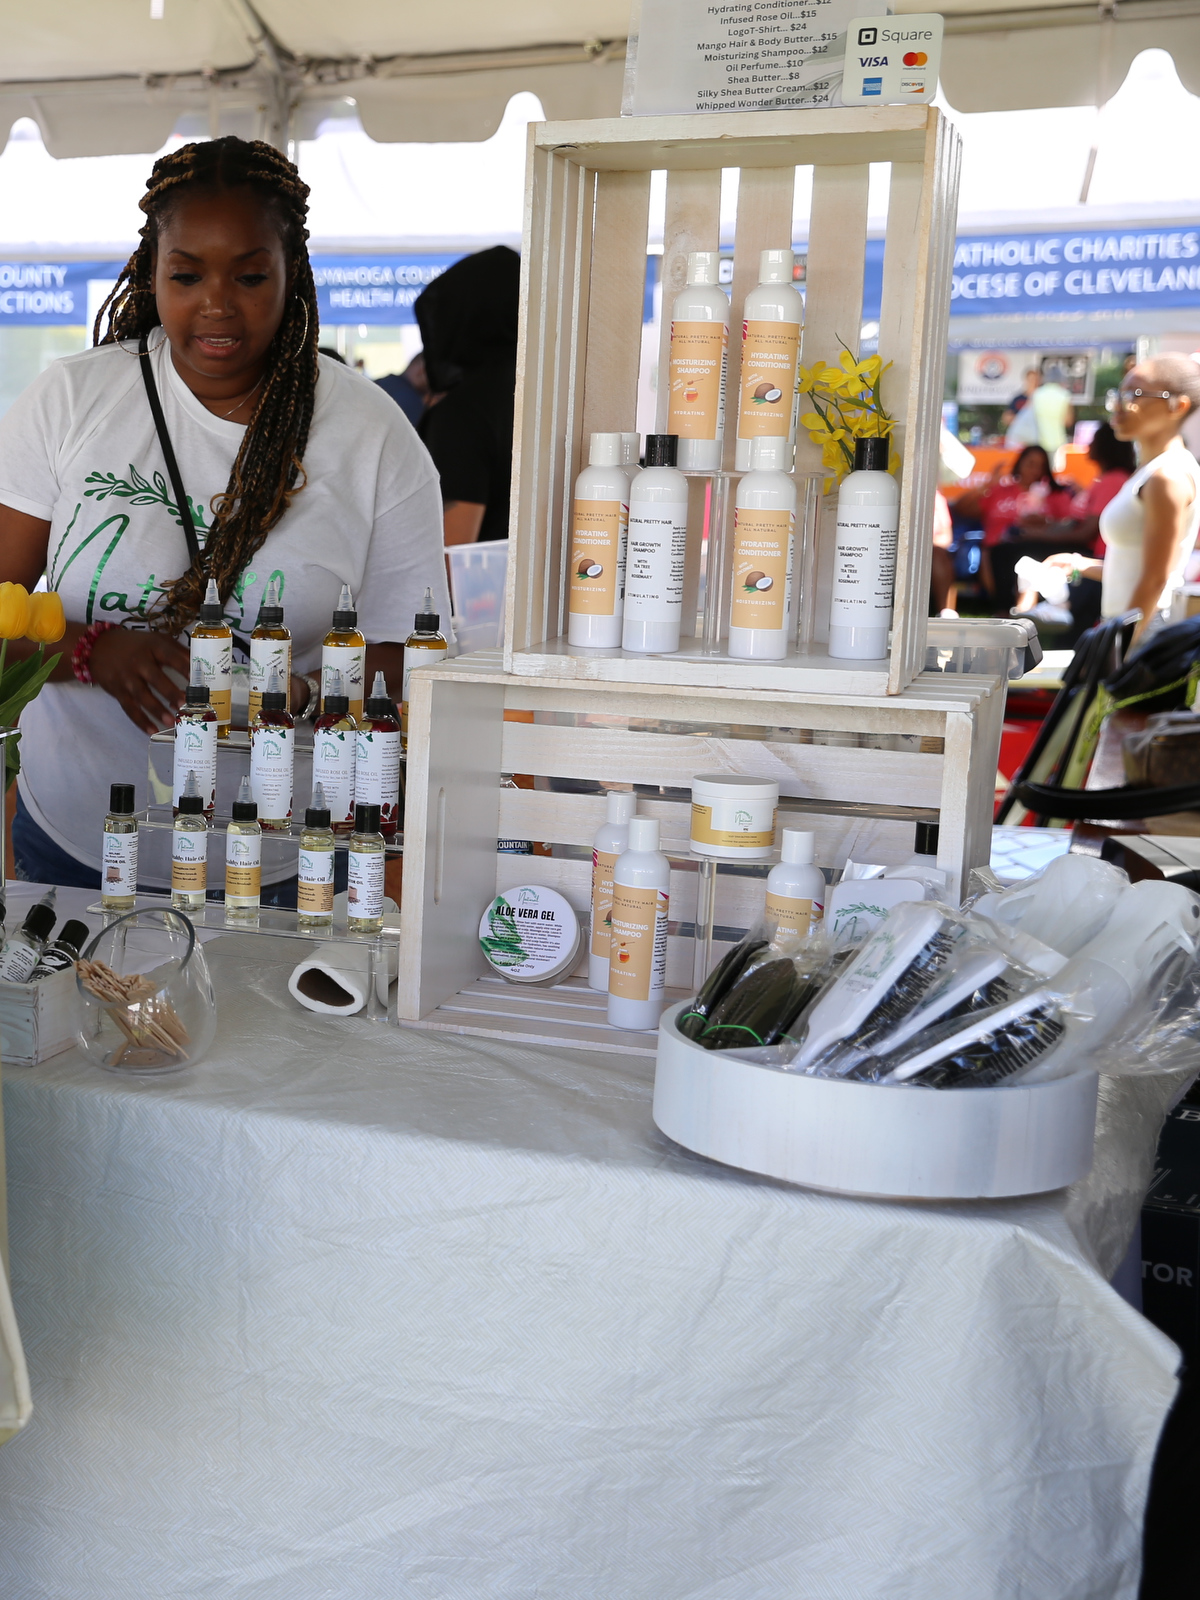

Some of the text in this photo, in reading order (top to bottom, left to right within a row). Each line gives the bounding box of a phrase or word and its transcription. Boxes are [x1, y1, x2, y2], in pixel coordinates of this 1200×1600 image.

[708, 2, 752, 15] Hydrating
[720, 10, 817, 25] Infused Rose Oil...$15
[790, 23, 807, 32] $24
[697, 42, 727, 51] Mango
[729, 40, 747, 48] Hair
[758, 37, 781, 47] Body
[784, 32, 837, 44] Butter...$15
[882, 29, 932, 43] Square
[704, 51, 759, 62] Moisturizing
[858, 56, 889, 67] VISA
[726, 64, 738, 72] Oil
[728, 76, 749, 84] Shea
[698, 89, 718, 98] Silky
[720, 88, 742, 96] Shea
[745, 86, 773, 95] Butter
[696, 101, 735, 111] Whipped
[738, 98, 775, 107] Wonder
[953, 231, 1200, 268] ATHOLIC CHARITIES
[312, 266, 395, 286] UYAHOGA
[951, 271, 1022, 300] OCESE
[1024, 270, 1062, 297] OF
[330, 288, 394, 308] HEALTH
[751, 352, 789, 360] HYDRATING
[748, 360, 791, 370] CONDITIONER
[746, 376, 764, 388] COCONUT
[748, 373, 758, 381] WITH
[740, 540, 779, 548] HYDRATING
[738, 549, 782, 557] CONDITIONER
[50, 503, 285, 633] Natal
[737, 564, 754, 576] COCONUT
[496, 905, 555, 921] ALOE VERA GEL
[613, 927, 642, 938] SHAMPOO
[777, 926, 798, 935] ATING
